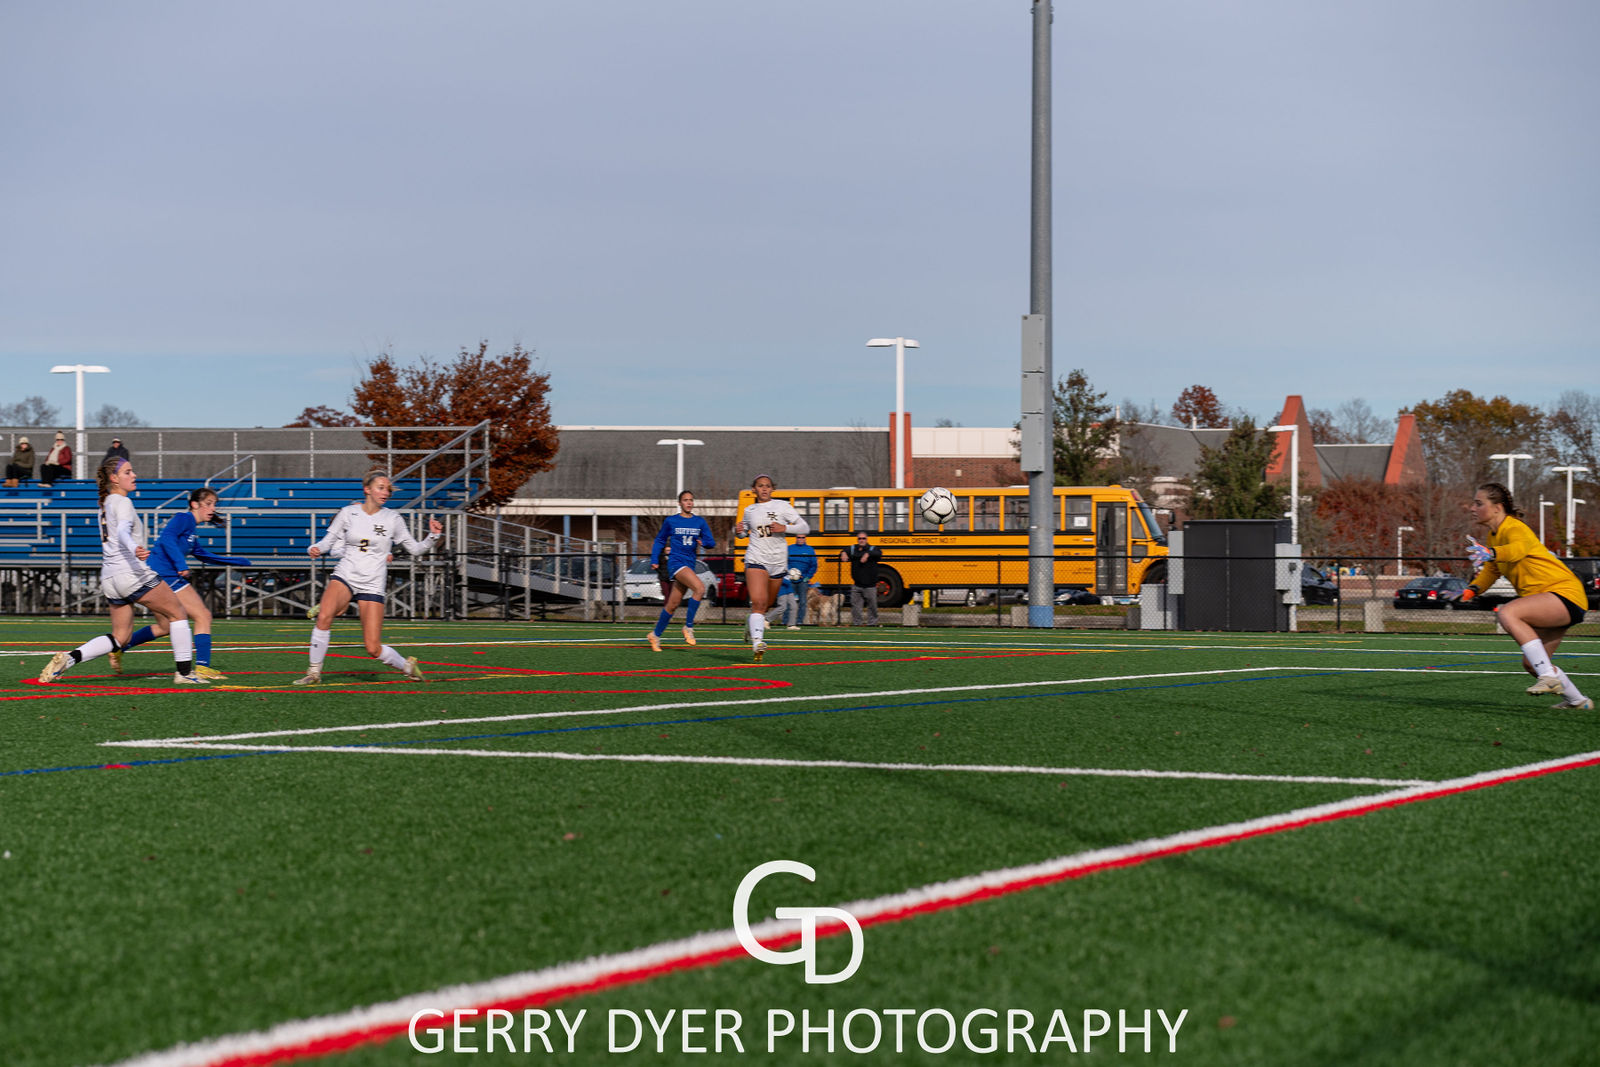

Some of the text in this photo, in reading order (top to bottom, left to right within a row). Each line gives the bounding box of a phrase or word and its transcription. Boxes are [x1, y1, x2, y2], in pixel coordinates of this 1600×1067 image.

[757, 525, 772, 538] 30
[360, 538, 369, 553] 2
[682, 535, 694, 546] 14
